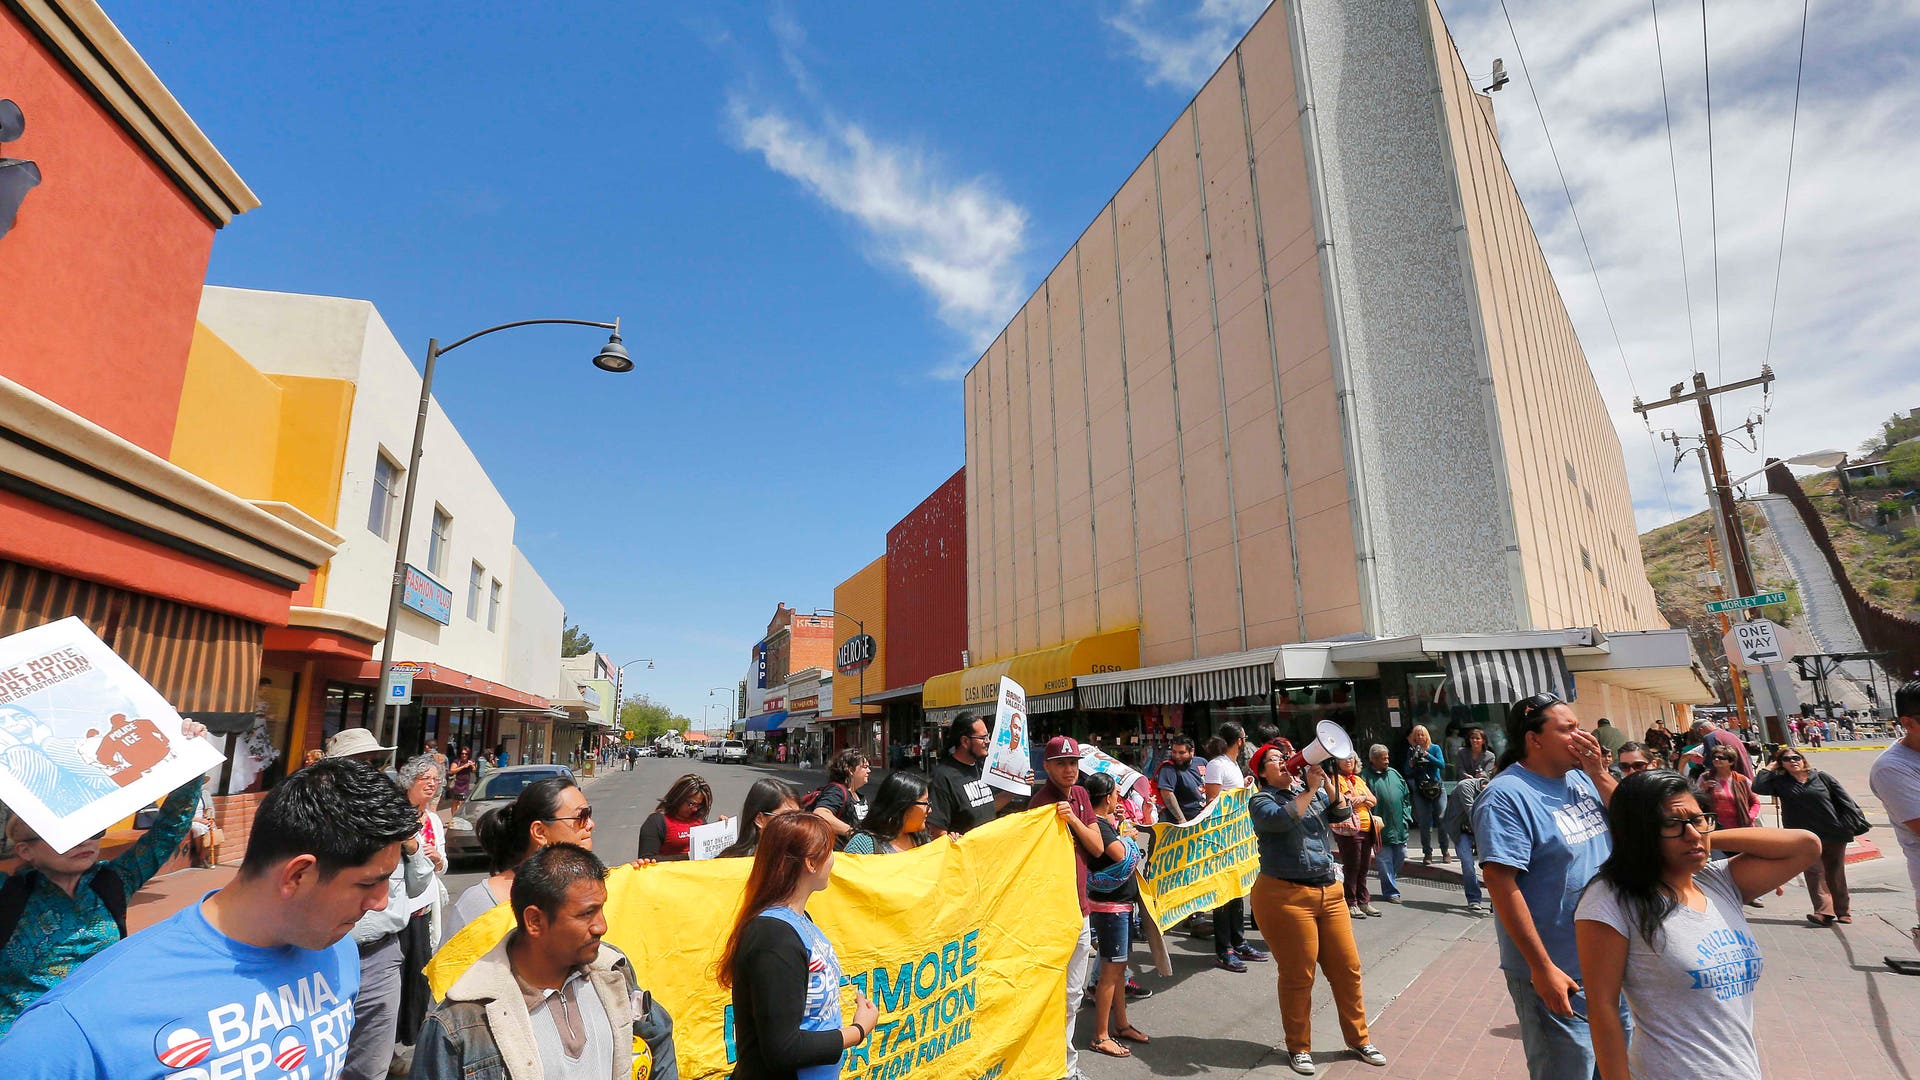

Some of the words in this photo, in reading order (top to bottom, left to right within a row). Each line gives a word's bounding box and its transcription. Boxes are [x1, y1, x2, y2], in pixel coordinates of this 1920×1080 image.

[405, 569, 434, 600] FASHION
[436, 588, 451, 609] PLUS
[1707, 603, 1715, 612] N
[1721, 597, 1757, 610] MORLEY
[1765, 593, 1786, 603] AVE
[1739, 625, 1769, 637] ONE
[1742, 636, 1771, 649] WAY
[0, 667, 24, 683] NE
[27, 647, 77, 671] MORE
[13, 671, 74, 699] DEPORTACION
[965, 687, 980, 701] CASA
[109, 721, 138, 741] POLICE
[121, 732, 142, 747] ICE
[1061, 739, 1073, 753] A
[703, 839, 713, 847] NOT
[1149, 845, 1184, 879] STOP
[1157, 863, 1200, 898] DEFERRED
[1202, 849, 1235, 877] ACTION
[1236, 842, 1249, 861] FOR
[1696, 929, 1760, 960] ARIZONA
[1699, 961, 1746, 988] DREAM
[1751, 958, 1763, 977] A
[916, 1032, 946, 1067] FOR
[947, 1018, 972, 1049] ALL
